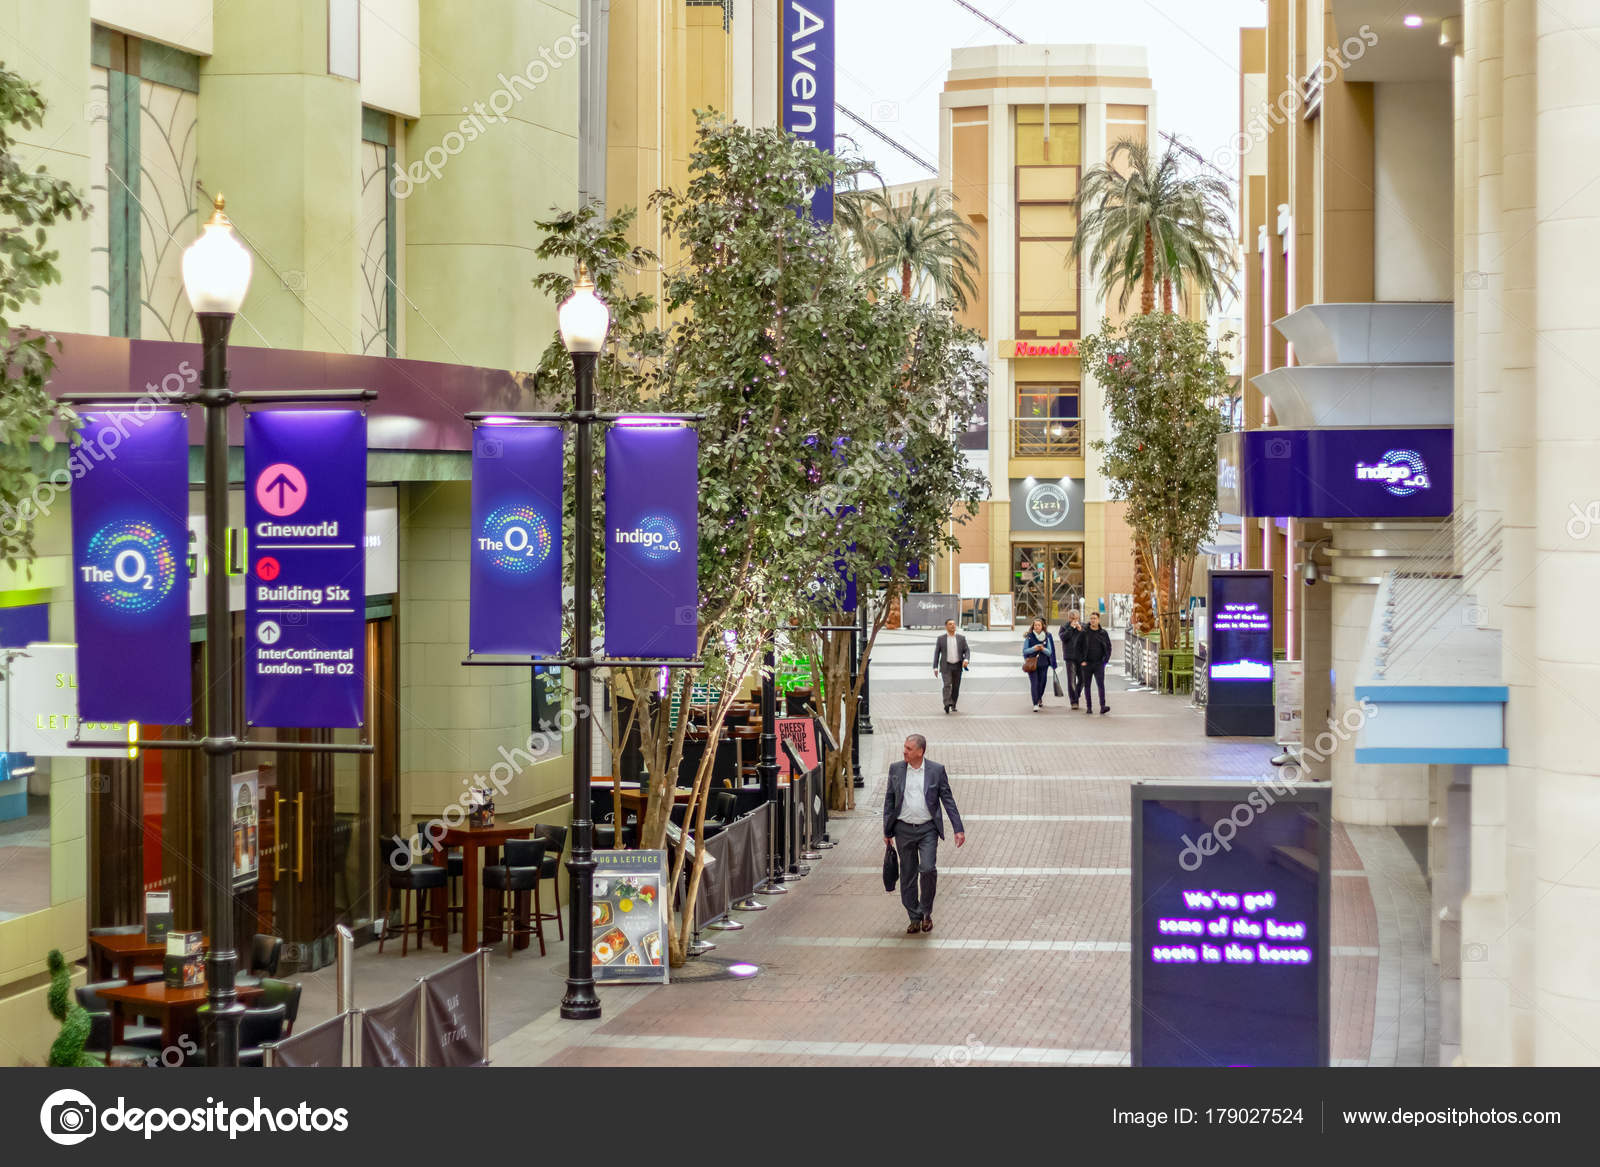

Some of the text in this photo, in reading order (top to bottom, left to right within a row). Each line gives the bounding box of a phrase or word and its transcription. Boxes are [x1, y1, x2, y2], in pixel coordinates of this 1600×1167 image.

[791, 1, 825, 202] Aven
[1356, 462, 1411, 483] indigo
[256, 521, 339, 538] Cineworld
[615, 528, 663, 547] indigo
[477, 537, 504, 551] The
[81, 565, 114, 582] The
[257, 585, 350, 605] Building Six
[257, 648, 354, 660] InterContinental
[257, 663, 302, 675] London
[313, 663, 335, 675] The
[337, 663, 354, 675] O2
[55, 673, 79, 688] SL
[779, 722, 805, 733] CHEESY
[620, 855, 658, 864] LETTUCE
[1183, 890, 1276, 913] We've got
[1159, 916, 1306, 940] some of the best
[1153, 943, 1311, 964] seats in the house
